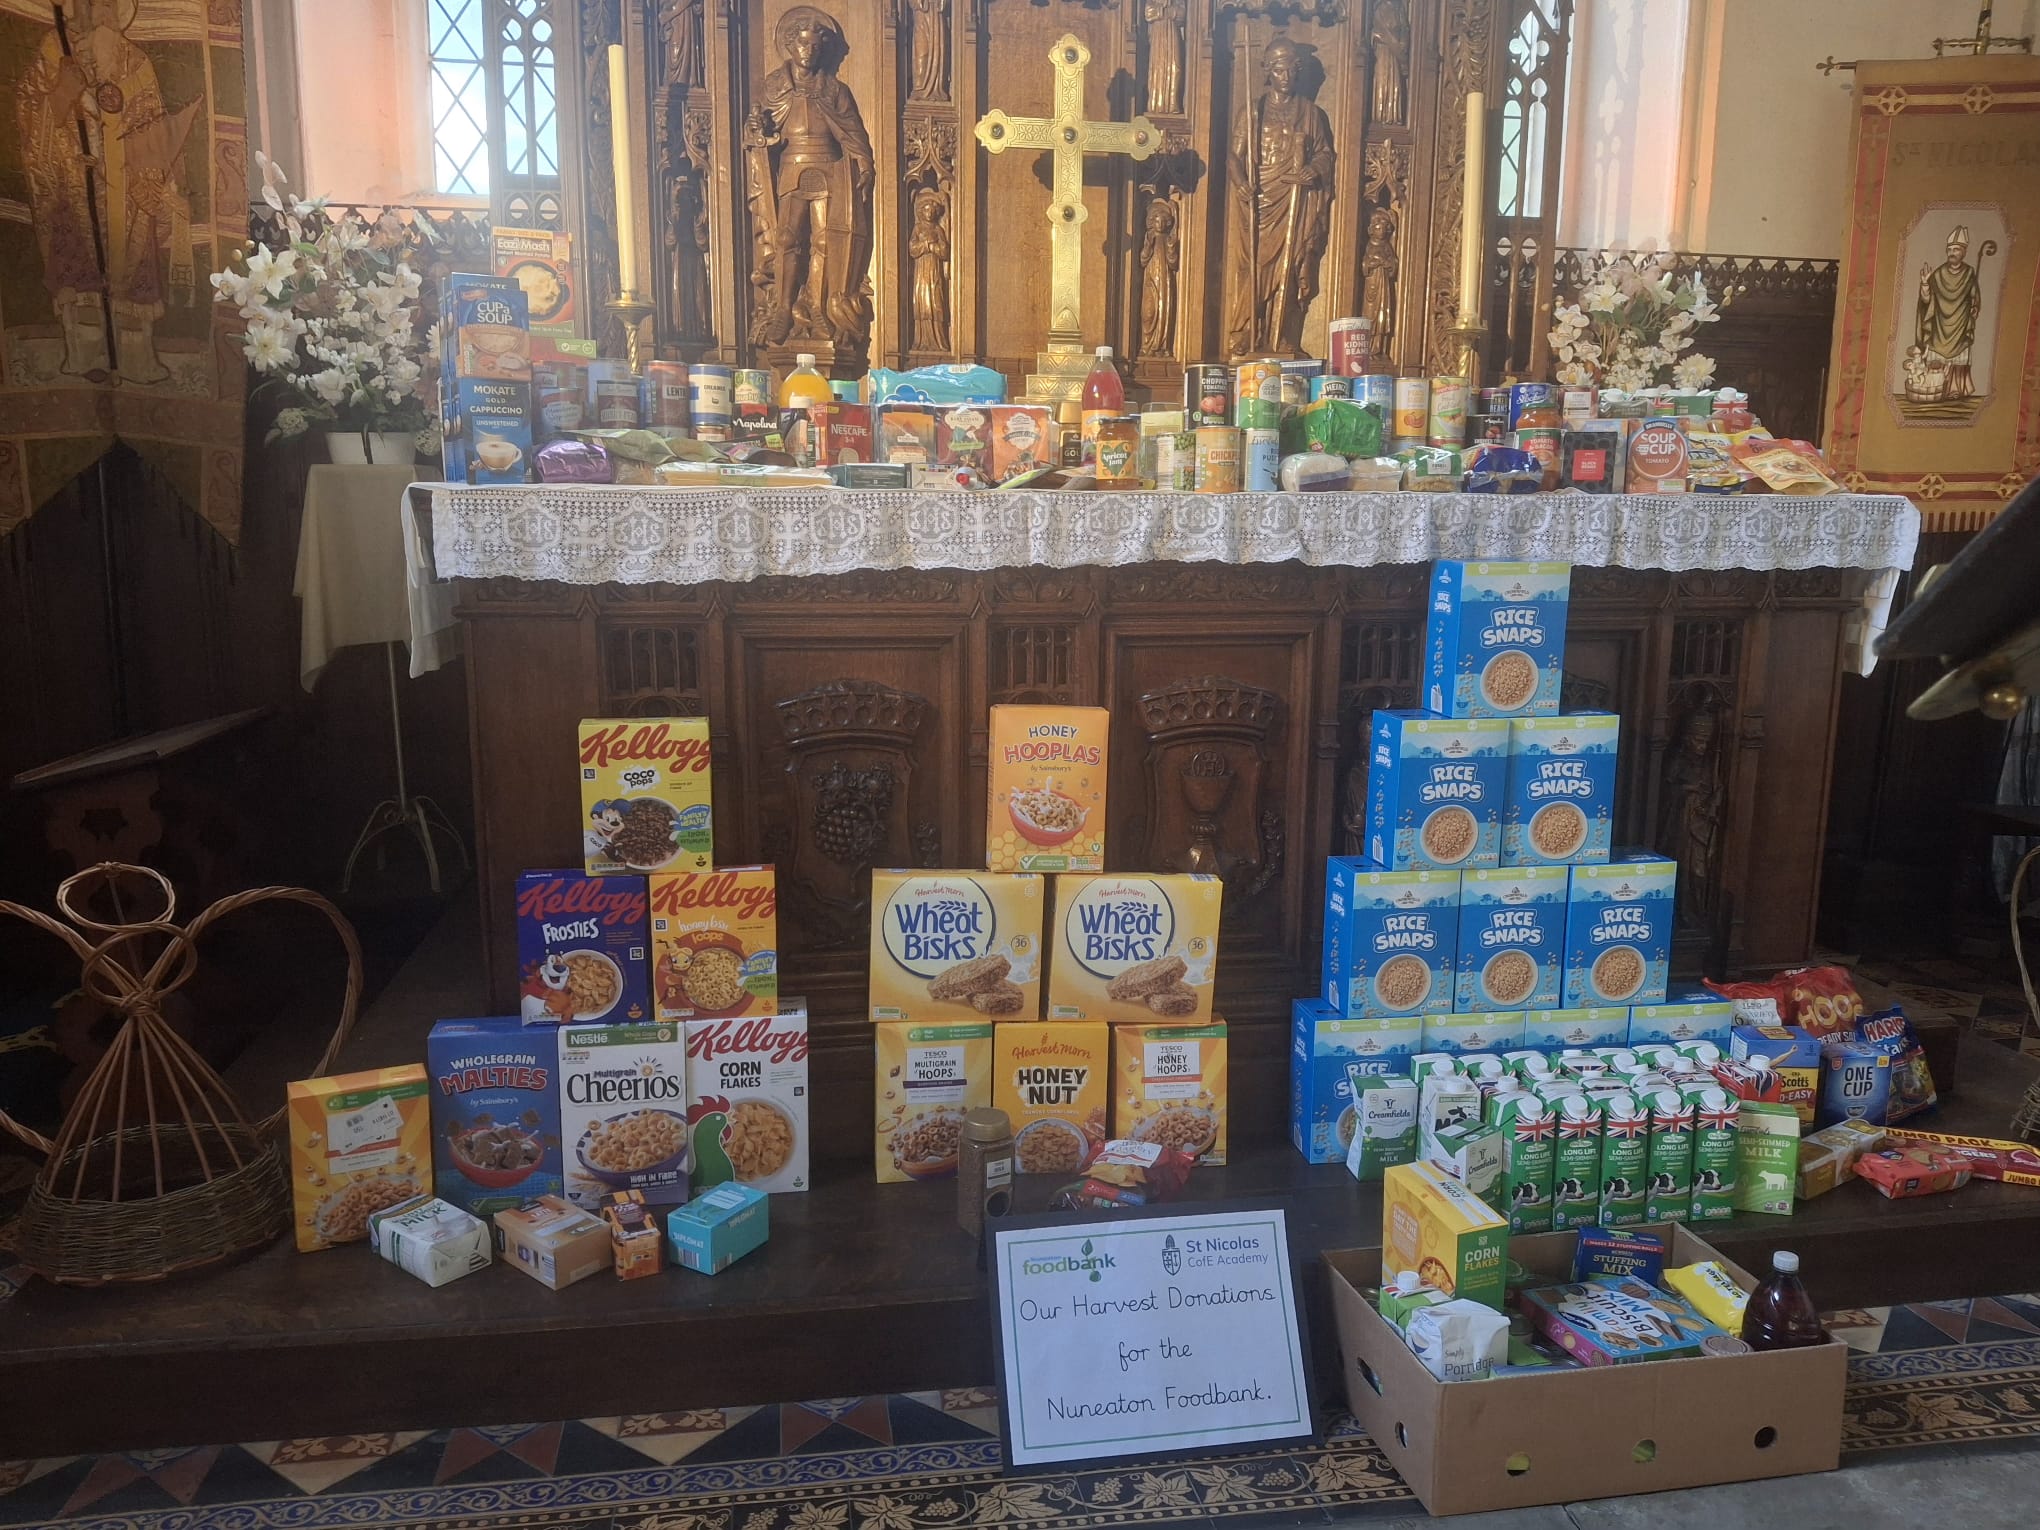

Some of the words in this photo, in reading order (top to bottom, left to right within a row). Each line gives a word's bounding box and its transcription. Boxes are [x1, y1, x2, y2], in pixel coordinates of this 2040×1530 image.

[477, 312, 513, 325] SOUP
[1350, 333, 1366, 341] RED
[474, 385, 517, 396] MOKATE
[470, 406, 523, 415] CAPPUCCINO
[732, 417, 778, 431] Napolina
[1640, 432, 1677, 444] SOUP
[1102, 451, 1128, 462] Apricot
[1650, 444, 1677, 456] CUP
[1493, 609, 1537, 627] RICE
[1482, 627, 1544, 646] SNAPS
[1028, 725, 1078, 738] HONEY
[1004, 742, 1100, 765] HOOPLAS
[624, 770, 656, 782] COCO
[1433, 765, 1476, 782] RICE
[1540, 762, 1584, 779] RICE
[630, 777, 654, 789] pops
[1529, 779, 1592, 797] SNAPS
[1420, 783, 1482, 800] SNAPS
[894, 902, 984, 934] Wheat
[1078, 902, 1164, 936] Wheat
[1386, 914, 1427, 931] RICE
[1492, 910, 1534, 928] RICE
[1602, 906, 1644, 923] RICE
[542, 917, 600, 945] FROSTIES
[678, 918, 710, 933] honey
[1592, 924, 1650, 942] SNAPS
[692, 932, 724, 945] loops
[1014, 938, 1027, 948] 36
[1192, 940, 1204, 950] 36
[1374, 932, 1434, 950] SNAPS
[1482, 928, 1542, 946] SNAPS
[904, 934, 976, 961] Bisks
[1085, 934, 1156, 961] Bisks
[924, 1050, 948, 1058] TESCO
[1012, 1046, 1060, 1059] Harvest
[1061, 1045, 1092, 1060] Morn
[1157, 1054, 1187, 1065] HONEY
[450, 1054, 536, 1070] WHOLEGRAIN
[720, 1061, 762, 1078] CORN
[914, 1060, 956, 1068] MULTIGRAIN
[1158, 1064, 1188, 1075] HOOPS
[1348, 1062, 1389, 1076] RICE
[439, 1066, 548, 1096] MALTIES
[594, 1068, 637, 1080] Multigrain
[918, 1068, 954, 1080] HOOPS
[1018, 1067, 1088, 1086] HONEY
[1844, 1067, 1873, 1082] ONE
[566, 1074, 680, 1104] Cheerios
[720, 1076, 761, 1090] FLAKES
[1844, 1081, 1874, 1096] CUP
[480, 1097, 518, 1106] Sainsbury's
[1028, 1085, 1078, 1106] NUT
[1368, 1110, 1411, 1120] Creamfields
[1886, 1128, 1941, 1142] JUMBO
[1944, 1134, 1992, 1147] PACK
[1745, 1147, 1782, 1158] MILK
[630, 1174, 647, 1183] HIGH
[648, 1174, 656, 1182] IN
[658, 1171, 678, 1180] FIBRE
[2006, 1174, 2037, 1186] JUMBO
[1438, 1181, 1462, 1198] CORN
[400, 1206, 447, 1228] MILK
[1186, 1239, 1202, 1253] St
[1207, 1236, 1260, 1251] Nicolas
[1188, 1256, 1214, 1268] CofE
[1217, 1252, 1269, 1267] Academy
[1464, 1246, 1500, 1263] CORN
[1593, 1254, 1647, 1268] STUFFING
[1022, 1252, 1116, 1276] foodbank
[1464, 1258, 1500, 1272] FLAKES
[1602, 1264, 1635, 1276] MIX
[1020, 1300, 1062, 1321] Our
[1073, 1290, 1159, 1317] Harvest
[1168, 1284, 1276, 1310] Donations
[1575, 1302, 1628, 1333] Family
[1586, 1294, 1654, 1332] Biscuit
[1118, 1341, 1150, 1372] for
[1158, 1336, 1193, 1360] the
[1444, 1348, 1464, 1358] Simply
[1444, 1357, 1494, 1377] Porridge
[1047, 1393, 1156, 1421] Nuneaton
[1166, 1378, 1272, 1410] Foodbank.
